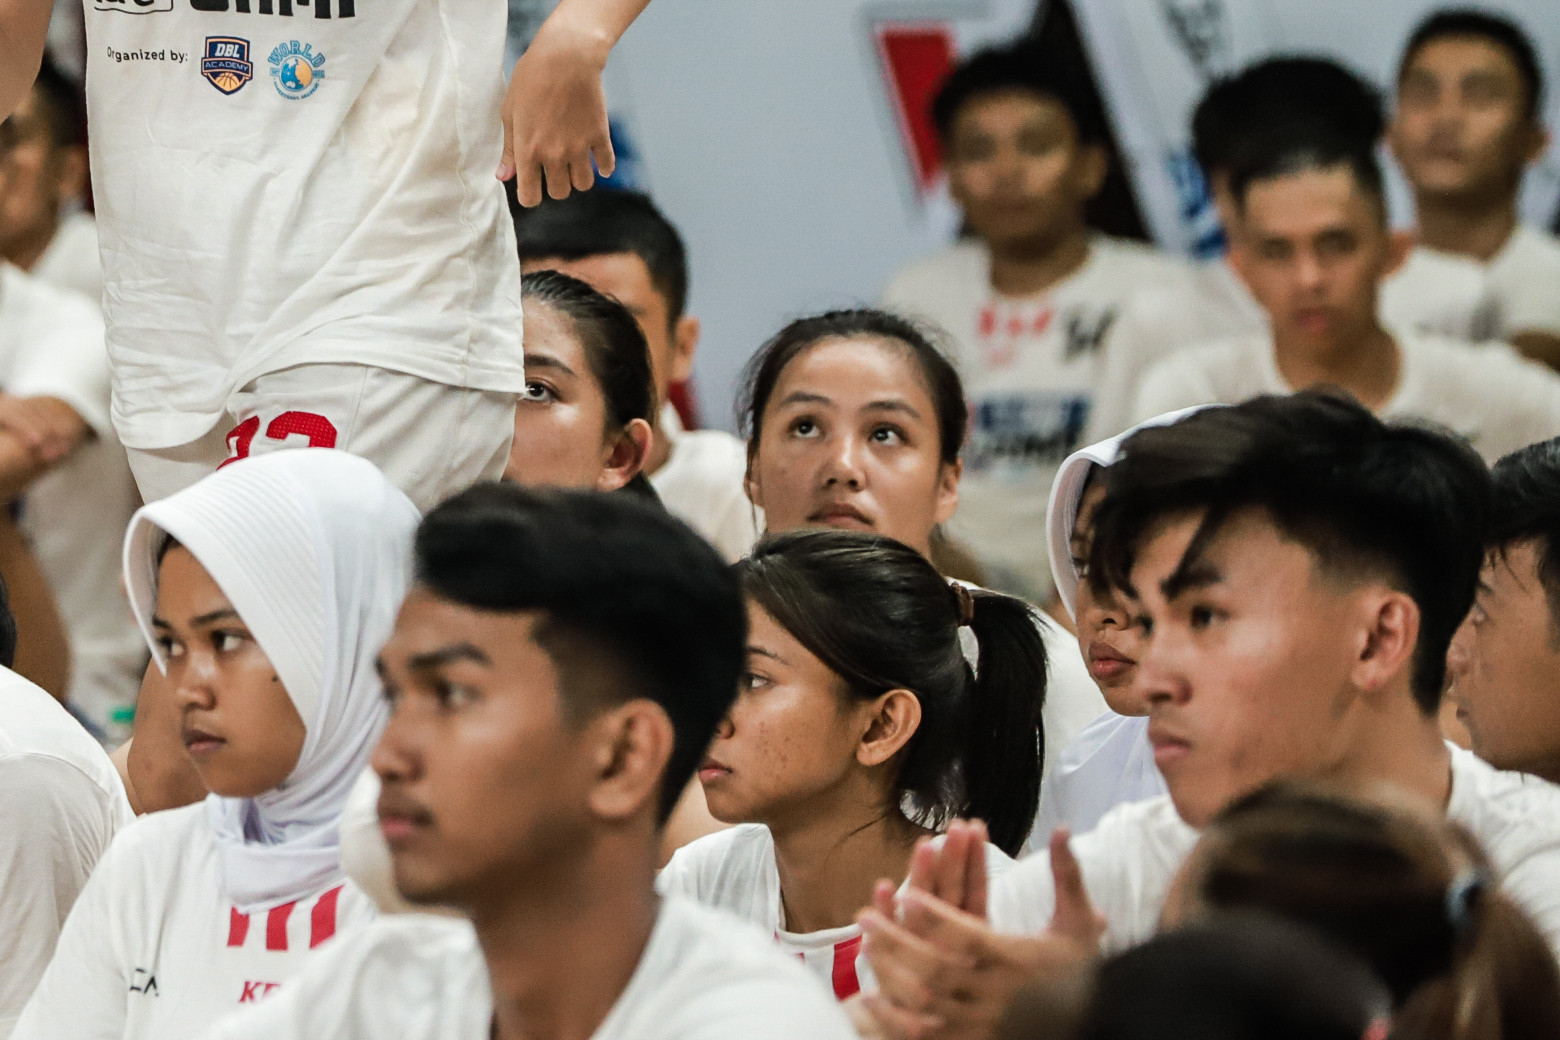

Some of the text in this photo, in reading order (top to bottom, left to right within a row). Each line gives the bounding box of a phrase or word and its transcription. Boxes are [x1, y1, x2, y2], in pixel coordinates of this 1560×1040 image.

[107, 46, 188, 64] Organized by:
[214, 43, 240, 58] DBL
[267, 40, 326, 68] WORLD
[204, 60, 249, 72] ACADEMY
[238, 980, 282, 1003] KF
